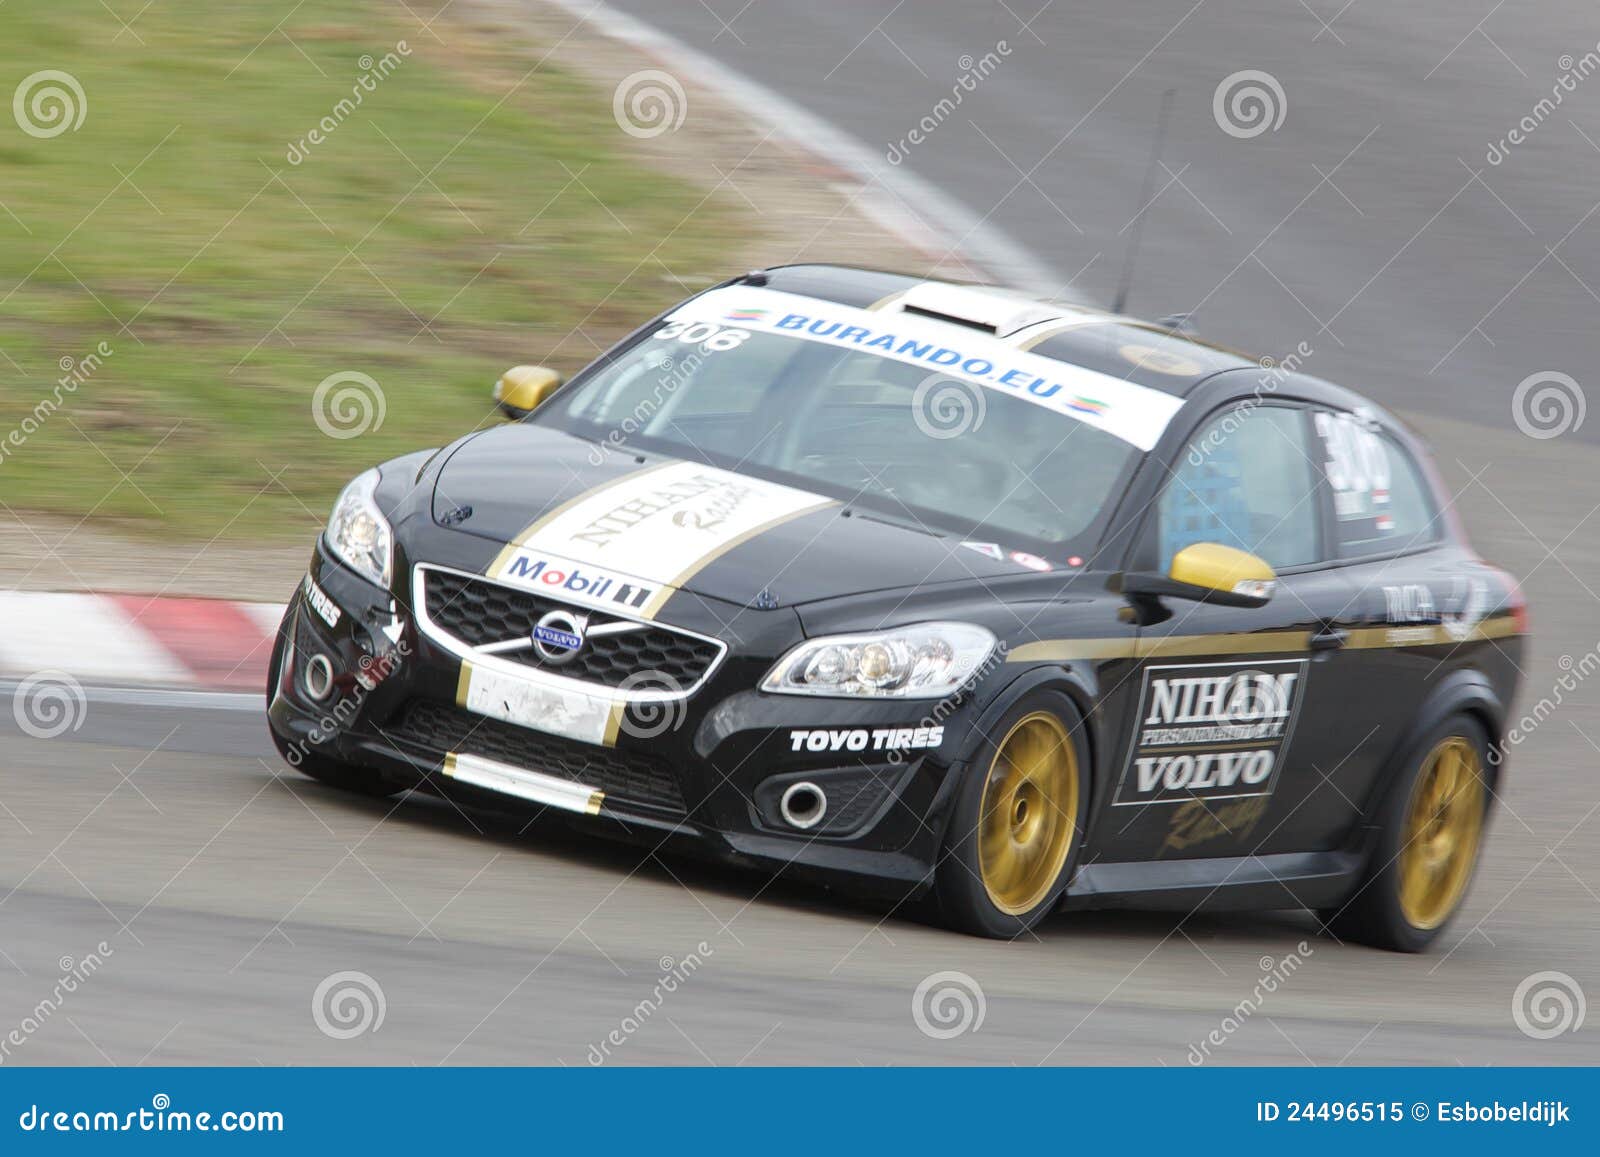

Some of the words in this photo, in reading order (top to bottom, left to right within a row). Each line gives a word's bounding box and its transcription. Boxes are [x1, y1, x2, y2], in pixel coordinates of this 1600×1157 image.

[652, 320, 751, 351] 306
[774, 313, 1063, 398] BURANDO.EU
[508, 556, 613, 598] Mobil
[537, 627, 578, 646] VOLVO
[790, 729, 869, 751] TOYO
[872, 726, 945, 750] TIRES
[1134, 750, 1276, 793] VOLVO
